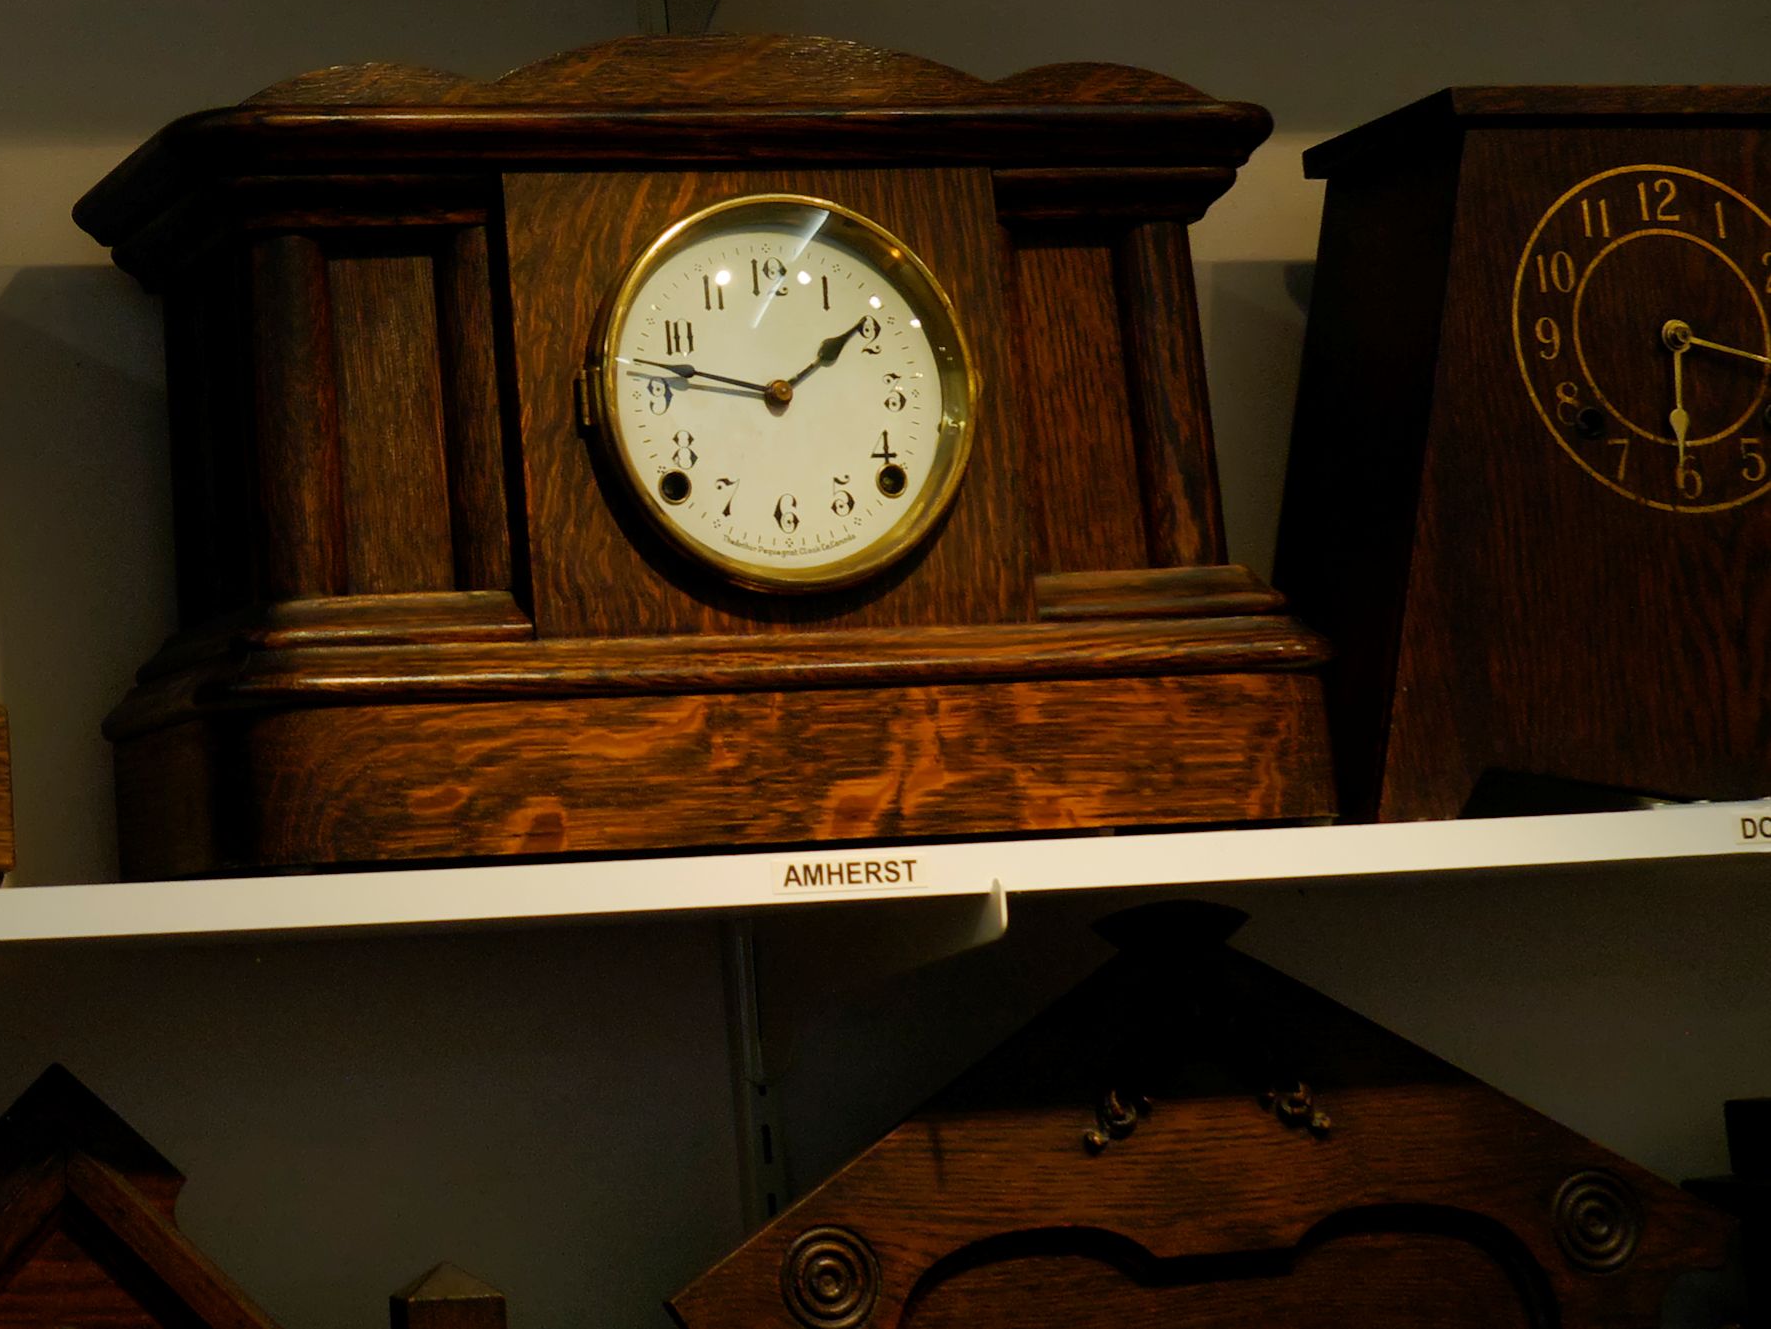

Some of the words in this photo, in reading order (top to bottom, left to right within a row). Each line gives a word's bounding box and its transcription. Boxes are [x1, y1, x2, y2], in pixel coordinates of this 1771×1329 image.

[1581, 197, 1611, 238] 11
[1637, 178, 1681, 222] 12
[1714, 201, 1726, 239] 1
[703, 274, 725, 311] 11
[750, 256, 788, 298] 12
[1536, 250, 1575, 294] 10
[821, 275, 830, 311] 1
[665, 318, 695, 357] 10
[860, 315, 882, 355] 2
[1535, 316, 1561, 361] 9
[647, 377, 674, 416] 9
[882, 372, 907, 412] 3
[1556, 381, 1579, 426] 8
[672, 429, 699, 470] 8
[870, 429, 898, 464] 4
[1607, 438, 1629, 482] 7
[1740, 438, 1766, 482] 5
[715, 477, 740, 517] 7
[831, 474, 855, 517] 5
[1675, 454, 1704, 500] 6
[773, 493, 800, 534] 6
[784, 860, 917, 887] AMHERST
